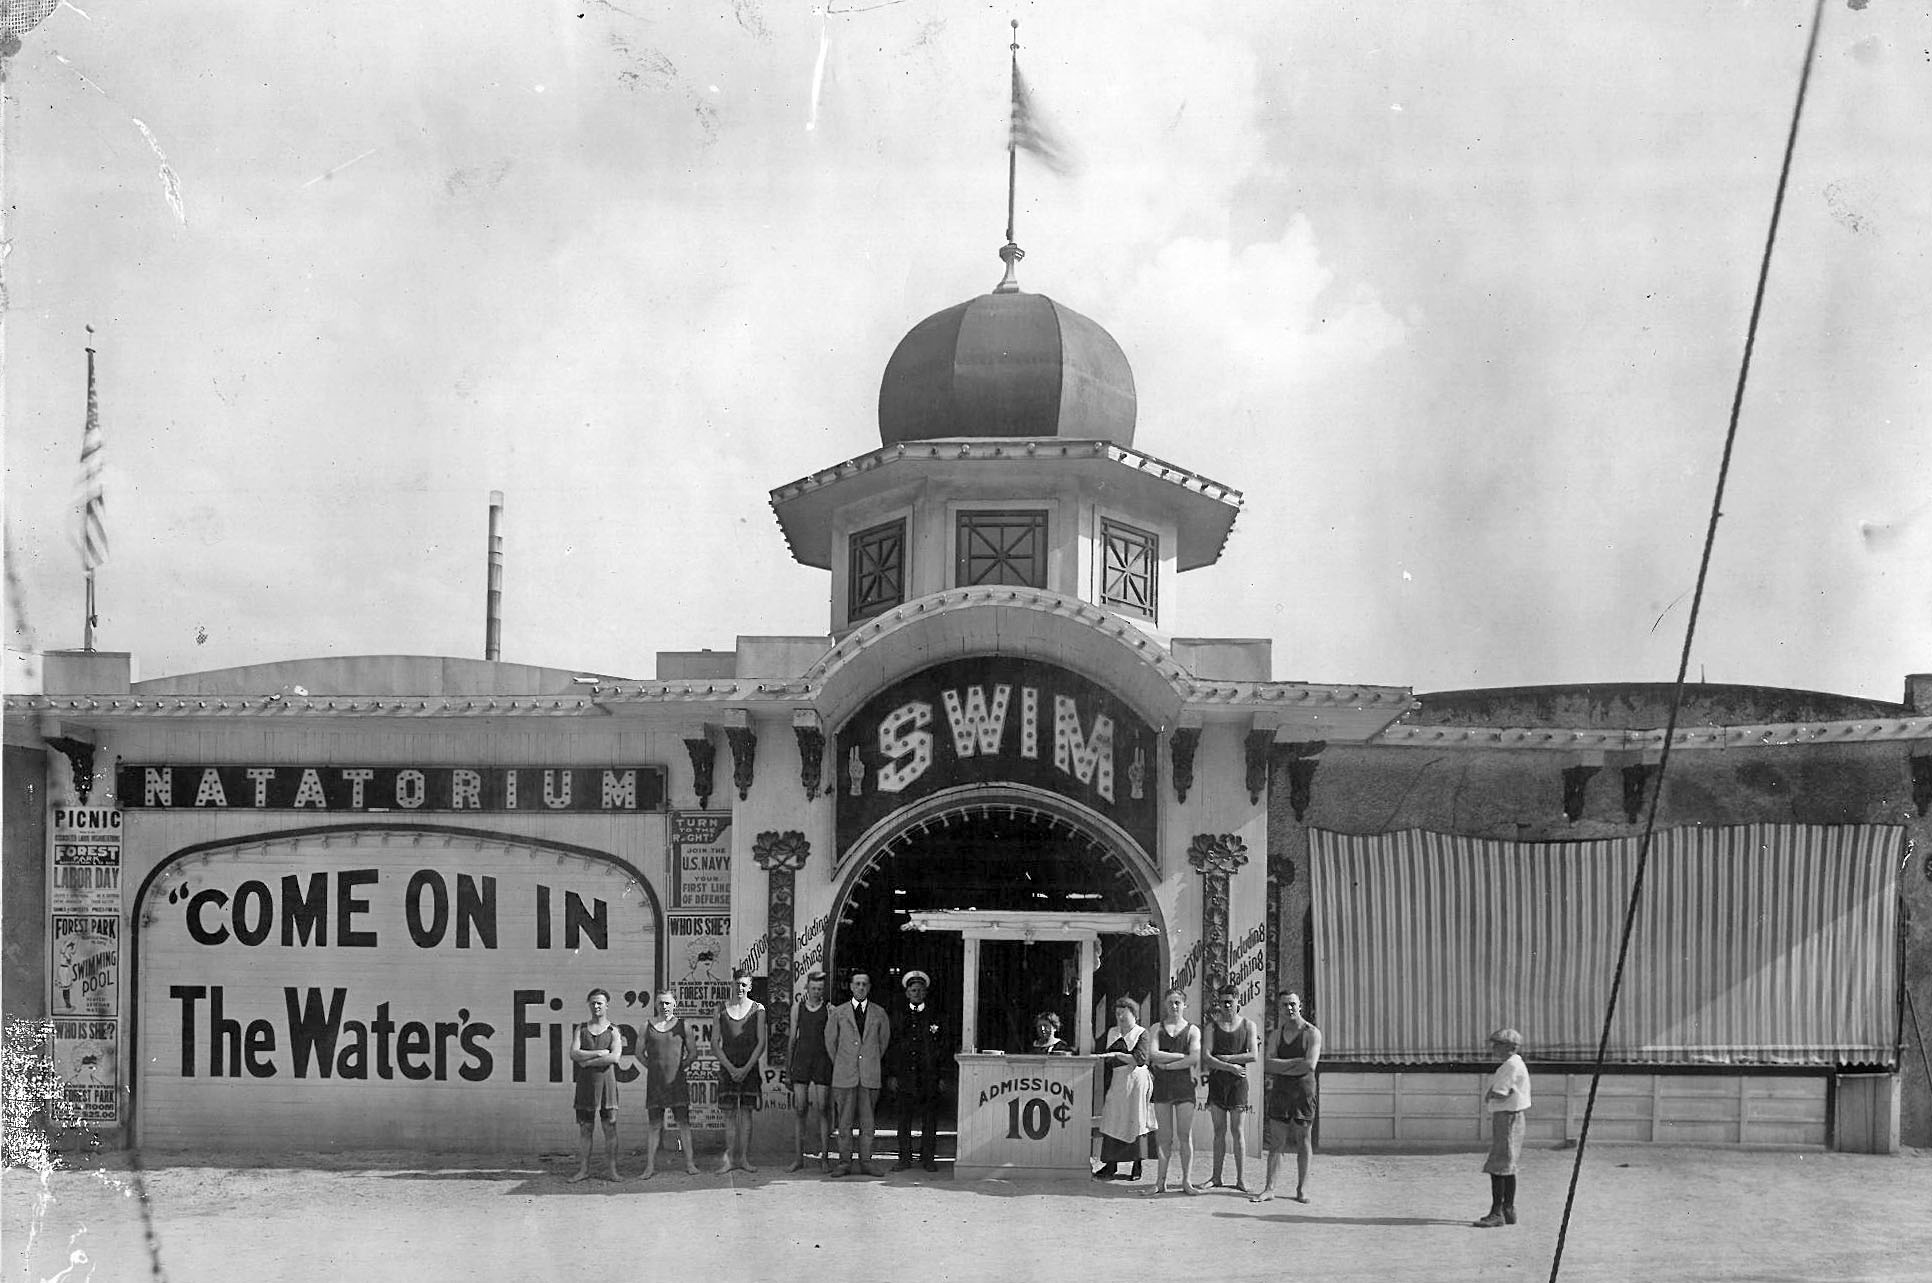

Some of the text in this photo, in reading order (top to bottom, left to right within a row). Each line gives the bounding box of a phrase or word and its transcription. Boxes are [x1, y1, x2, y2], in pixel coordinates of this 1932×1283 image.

[877, 684, 1115, 805] SWIM
[145, 767, 637, 809] NATATORIUM
[54, 810, 121, 828] PICNIC
[675, 818, 718, 827] TURN
[55, 846, 119, 861] FOREST
[702, 856, 730, 871] NAVY
[53, 867, 120, 889] LABOR DAY
[682, 883, 731, 893] FIRST LINE
[405, 869, 498, 949] ON
[536, 884, 608, 949] IN
[682, 895, 692, 905] OF
[55, 918, 116, 940] FOREST PARK
[670, 918, 731, 936] WHO IS SHE?
[794, 914, 829, 953] Including
[1229, 922, 1265, 968] Including
[72, 951, 117, 982] SWIMMING
[794, 944, 823, 984] Bathing
[1229, 949, 1264, 986] Bathing
[82, 971, 115, 997] POOL
[680, 987, 708, 1000] FOREST
[1238, 981, 1261, 1007] uits
[55, 1022, 115, 1040] WHO IS SHE?
[169, 985, 650, 1083] The Water’s Fie”
[95, 1089, 115, 1103] PARK
[978, 1077, 1075, 1107] ADMISSION
[1005, 1097, 1071, 1141] 10¢
